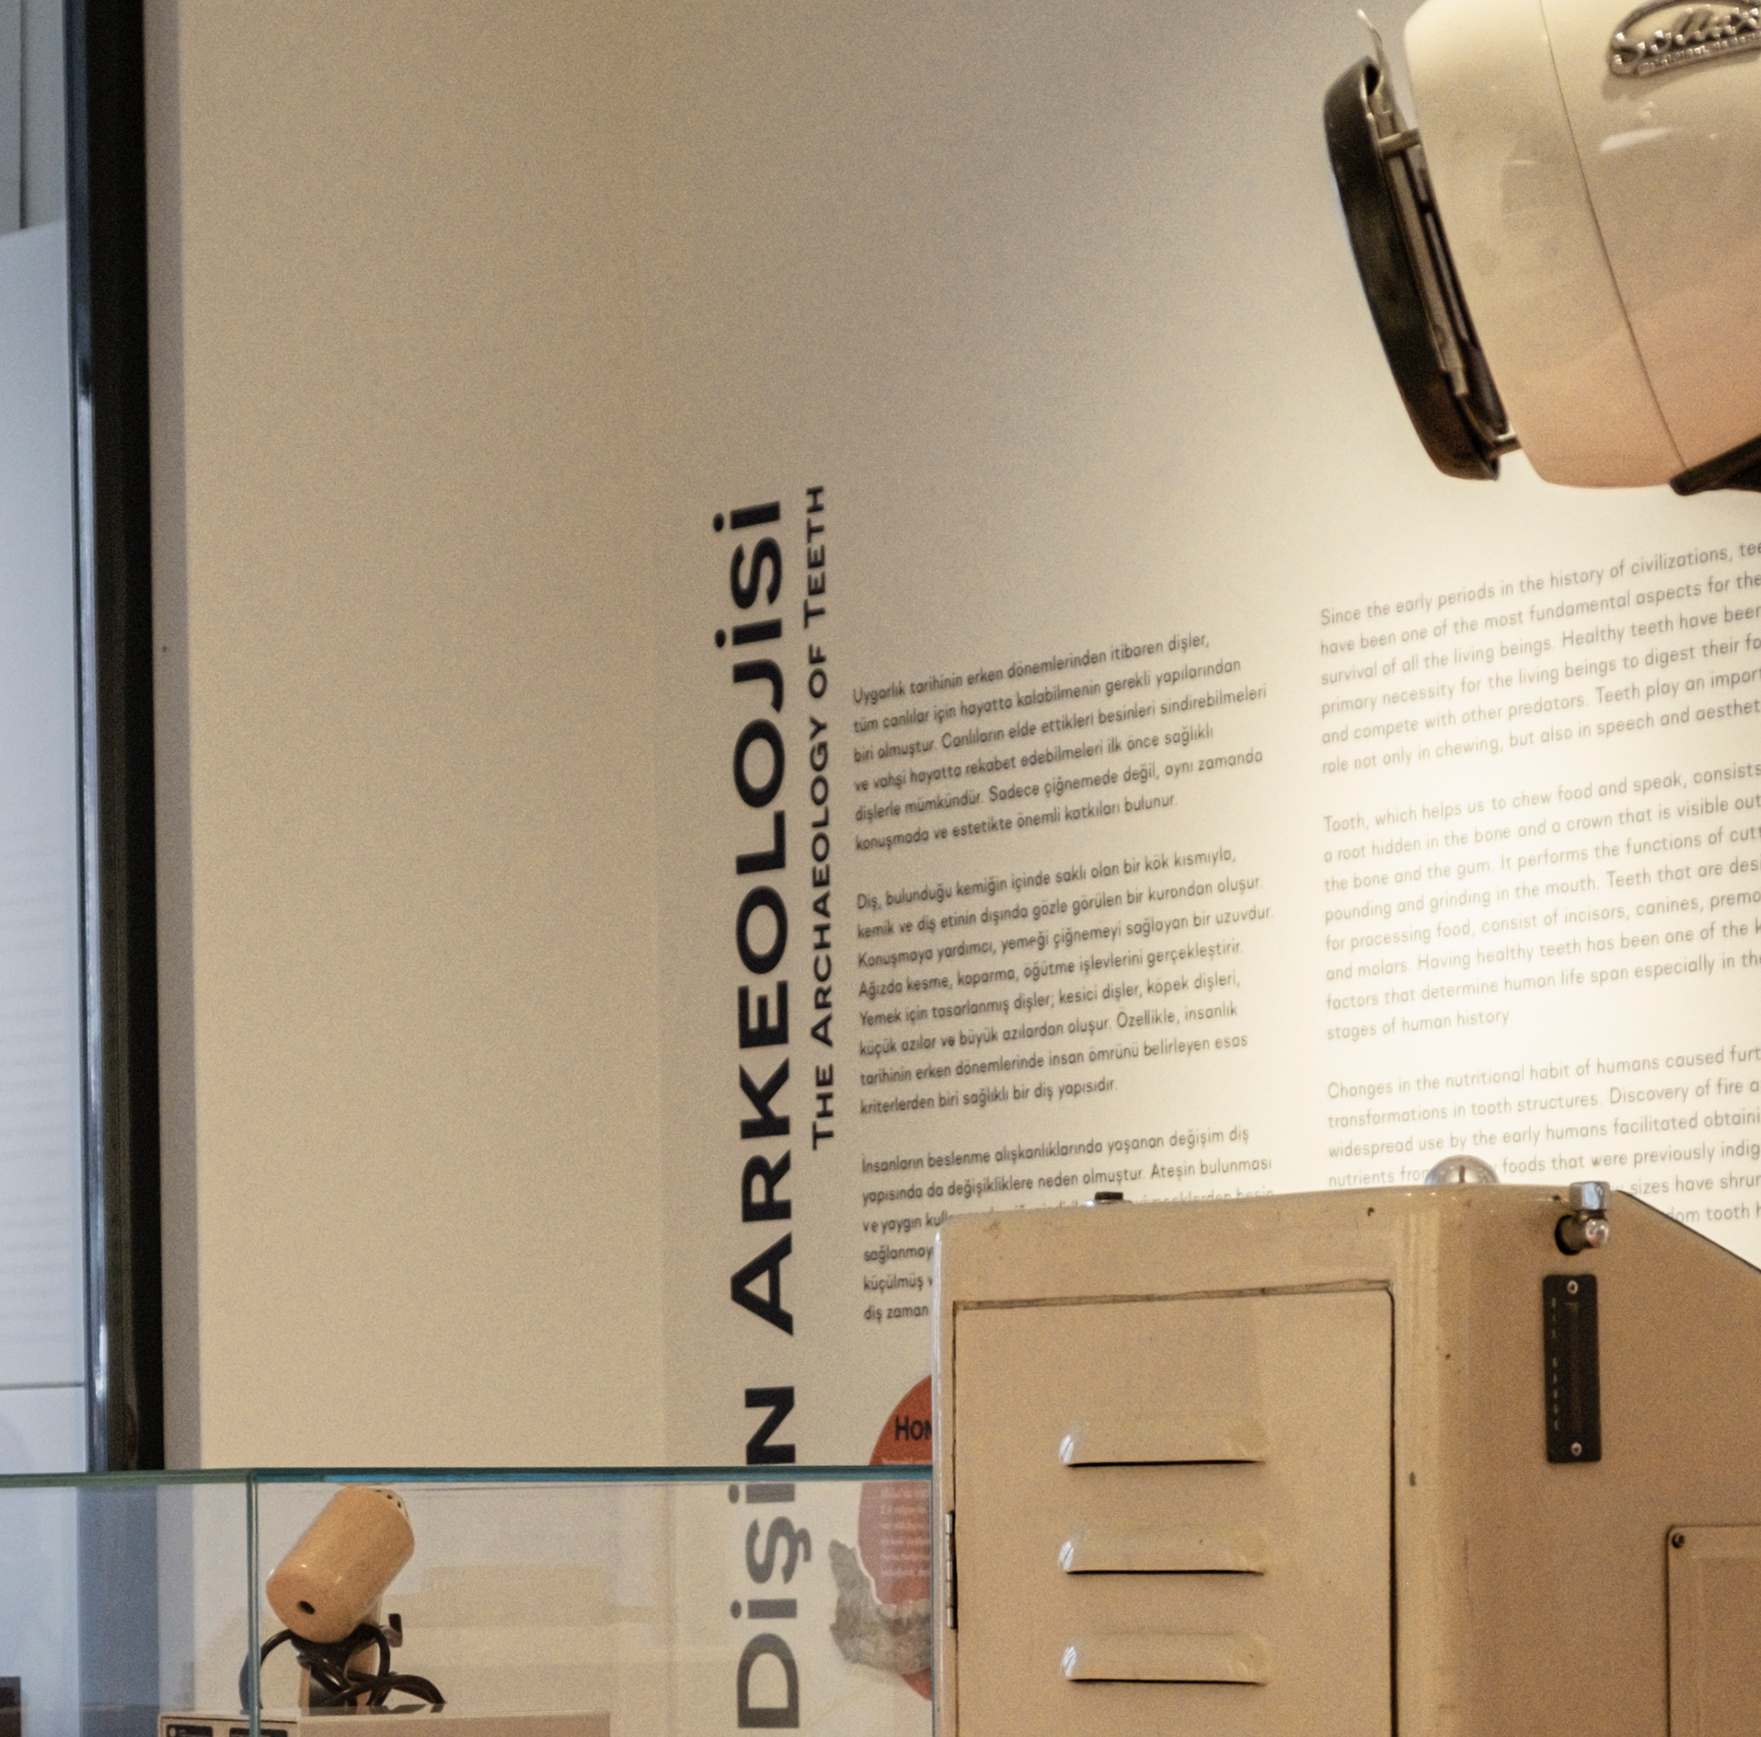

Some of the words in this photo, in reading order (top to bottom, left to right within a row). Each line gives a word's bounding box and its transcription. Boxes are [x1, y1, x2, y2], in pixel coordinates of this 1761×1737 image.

[803, 485, 826, 629] TEETH
[1319, 606, 1361, 627] Since
[1365, 600, 1390, 619] the
[1394, 593, 1432, 614] early
[1437, 582, 1495, 611] periods
[1500, 582, 1513, 596] in
[1518, 575, 1544, 594] the
[1549, 568, 1604, 588] history
[1608, 557, 1625, 579] of
[1629, 546, 1733, 576] civilizations,
[1319, 638, 1355, 656] have
[1359, 631, 1396, 650] been
[1400, 626, 1427, 643] one
[1432, 618, 1447, 638] of
[1452, 617, 1478, 635] the
[1483, 609, 1523, 629] most
[1528, 589, 1630, 622] fundamental
[1634, 582, 1702, 607] aspects
[1705, 573, 1730, 595] for
[807, 644, 828, 700] OF
[1321, 725, 1348, 745] and
[1353, 718, 1418, 740] compete
[1424, 710, 1456, 729] with
[1461, 706, 1501, 724] other
[1507, 694, 1588, 721] predators.
[1594, 682, 1640, 704] Teeth
[1644, 678, 1679, 702] play
[1683, 676, 1705, 693] an
[808, 714, 835, 1049] ARCHAEOLOGY
[1324, 901, 1391, 925] pounding
[1396, 896, 1424, 914] and
[1429, 889, 1490, 914] grinding
[1496, 888, 1508, 900] in
[1514, 883, 1539, 898] the
[1545, 874, 1599, 894] mouth.
[1605, 866, 1651, 888] Teeth
[1656, 864, 1691, 883] that
[1696, 862, 1723, 879] are
[1324, 933, 1344, 951] for
[1349, 927, 1431, 952] processing
[1436, 919, 1474, 938] food,
[1481, 914, 1536, 934] consist
[1543, 908, 1558, 927] of
[1563, 905, 1629, 924] incisors,
[1635, 896, 1704, 917] canines,
[811, 1064, 835, 1151] THE
[1326, 1080, 1393, 1101] Changes
[1398, 1079, 1410, 1092] in
[1415, 1074, 1440, 1091] the
[1445, 1065, 1524, 1088] nutritional
[1529, 1061, 1569, 1081] habit
[1574, 1057, 1590, 1078] of
[1595, 1056, 1660, 1075] humans
[1664, 1045, 1724, 1069] caused
